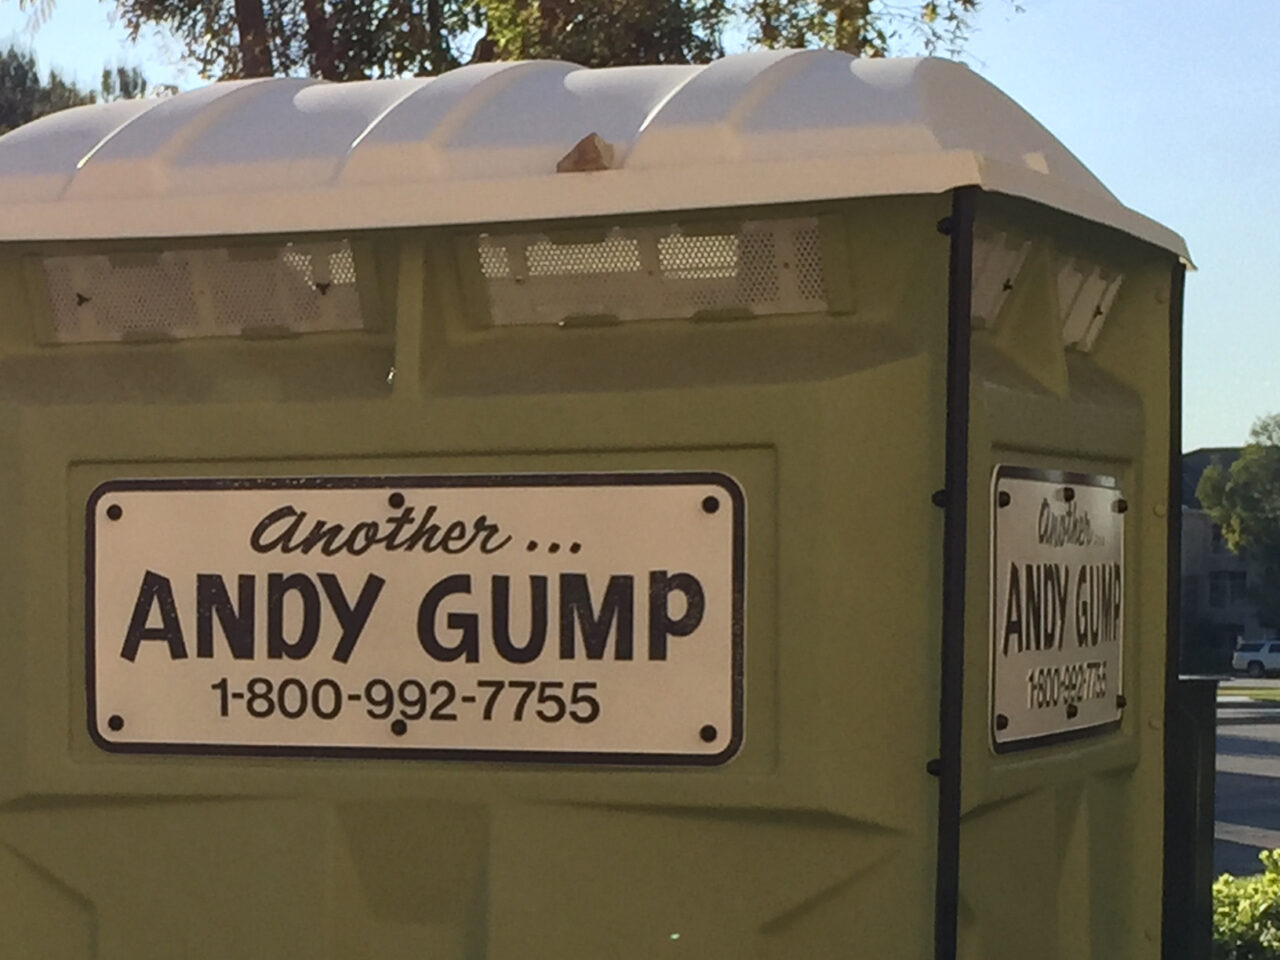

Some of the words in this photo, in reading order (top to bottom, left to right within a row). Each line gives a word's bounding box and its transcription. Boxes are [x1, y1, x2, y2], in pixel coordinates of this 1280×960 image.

[120, 570, 386, 664] ANDY
[417, 570, 705, 664] GUMP
[1003, 561, 1069, 658] ANDY
[1076, 561, 1121, 648] GUMP
[211, 677, 600, 724] 1-800-992-7755
